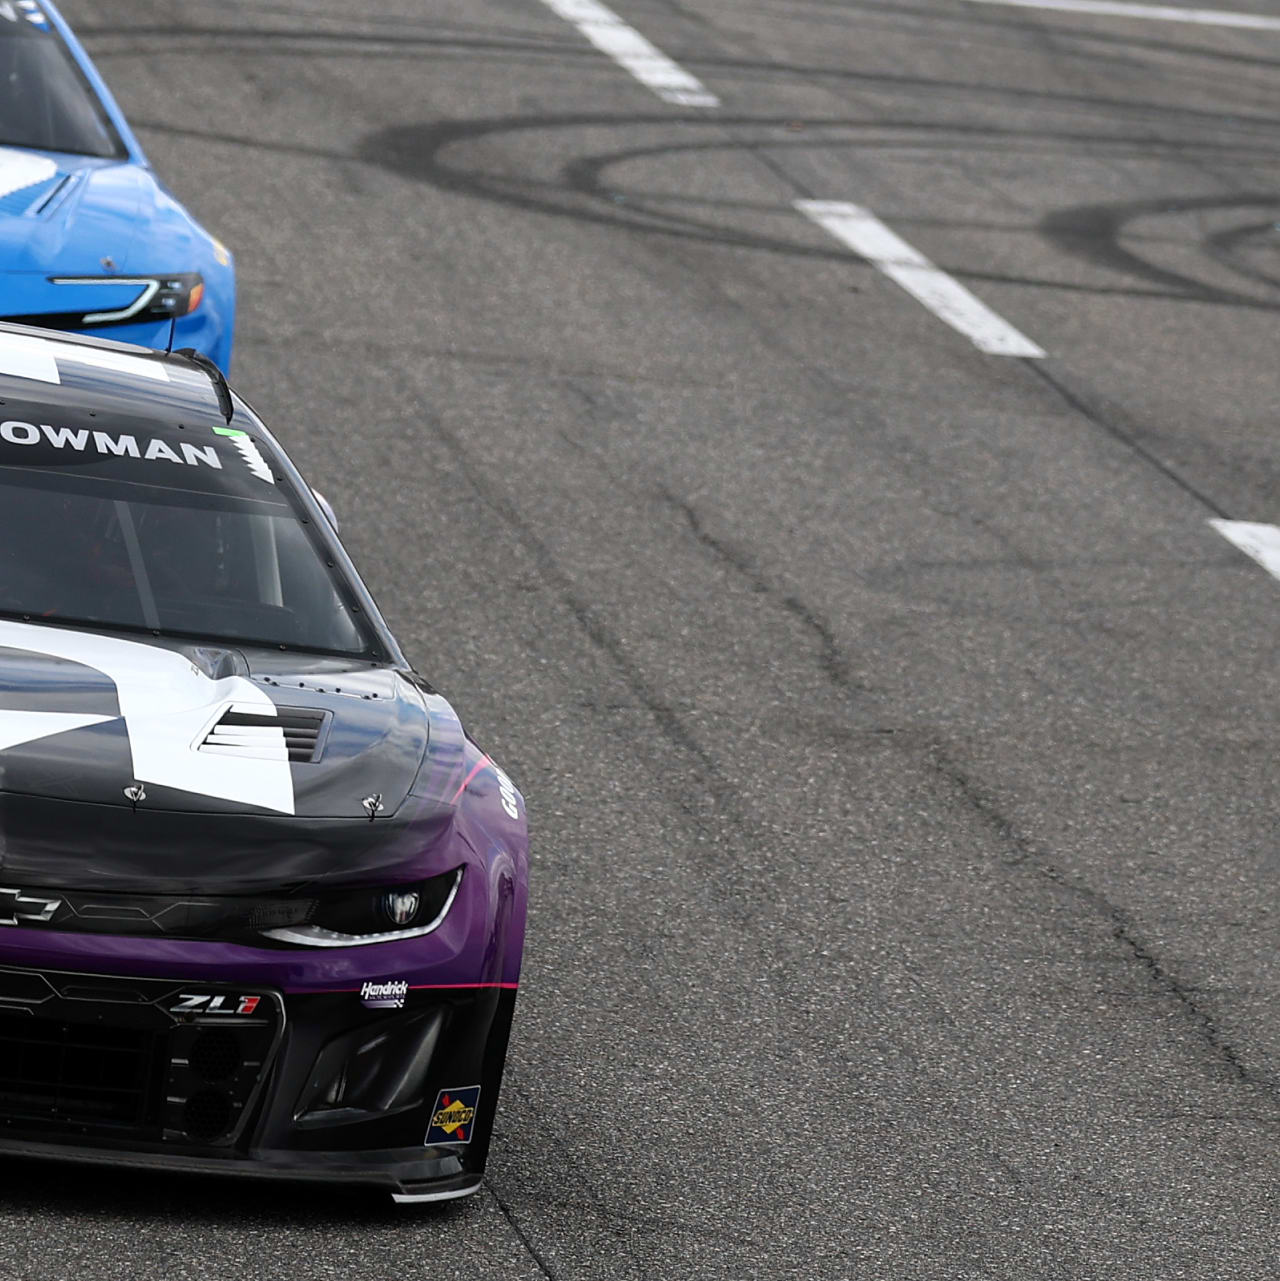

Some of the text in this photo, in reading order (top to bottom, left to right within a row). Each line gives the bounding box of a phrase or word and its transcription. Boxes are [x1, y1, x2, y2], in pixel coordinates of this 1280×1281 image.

[360, 980, 408, 1000] Hendrick
[169, 994, 261, 1014] ZL1
[432, 1107, 474, 1126] SUNOCO
